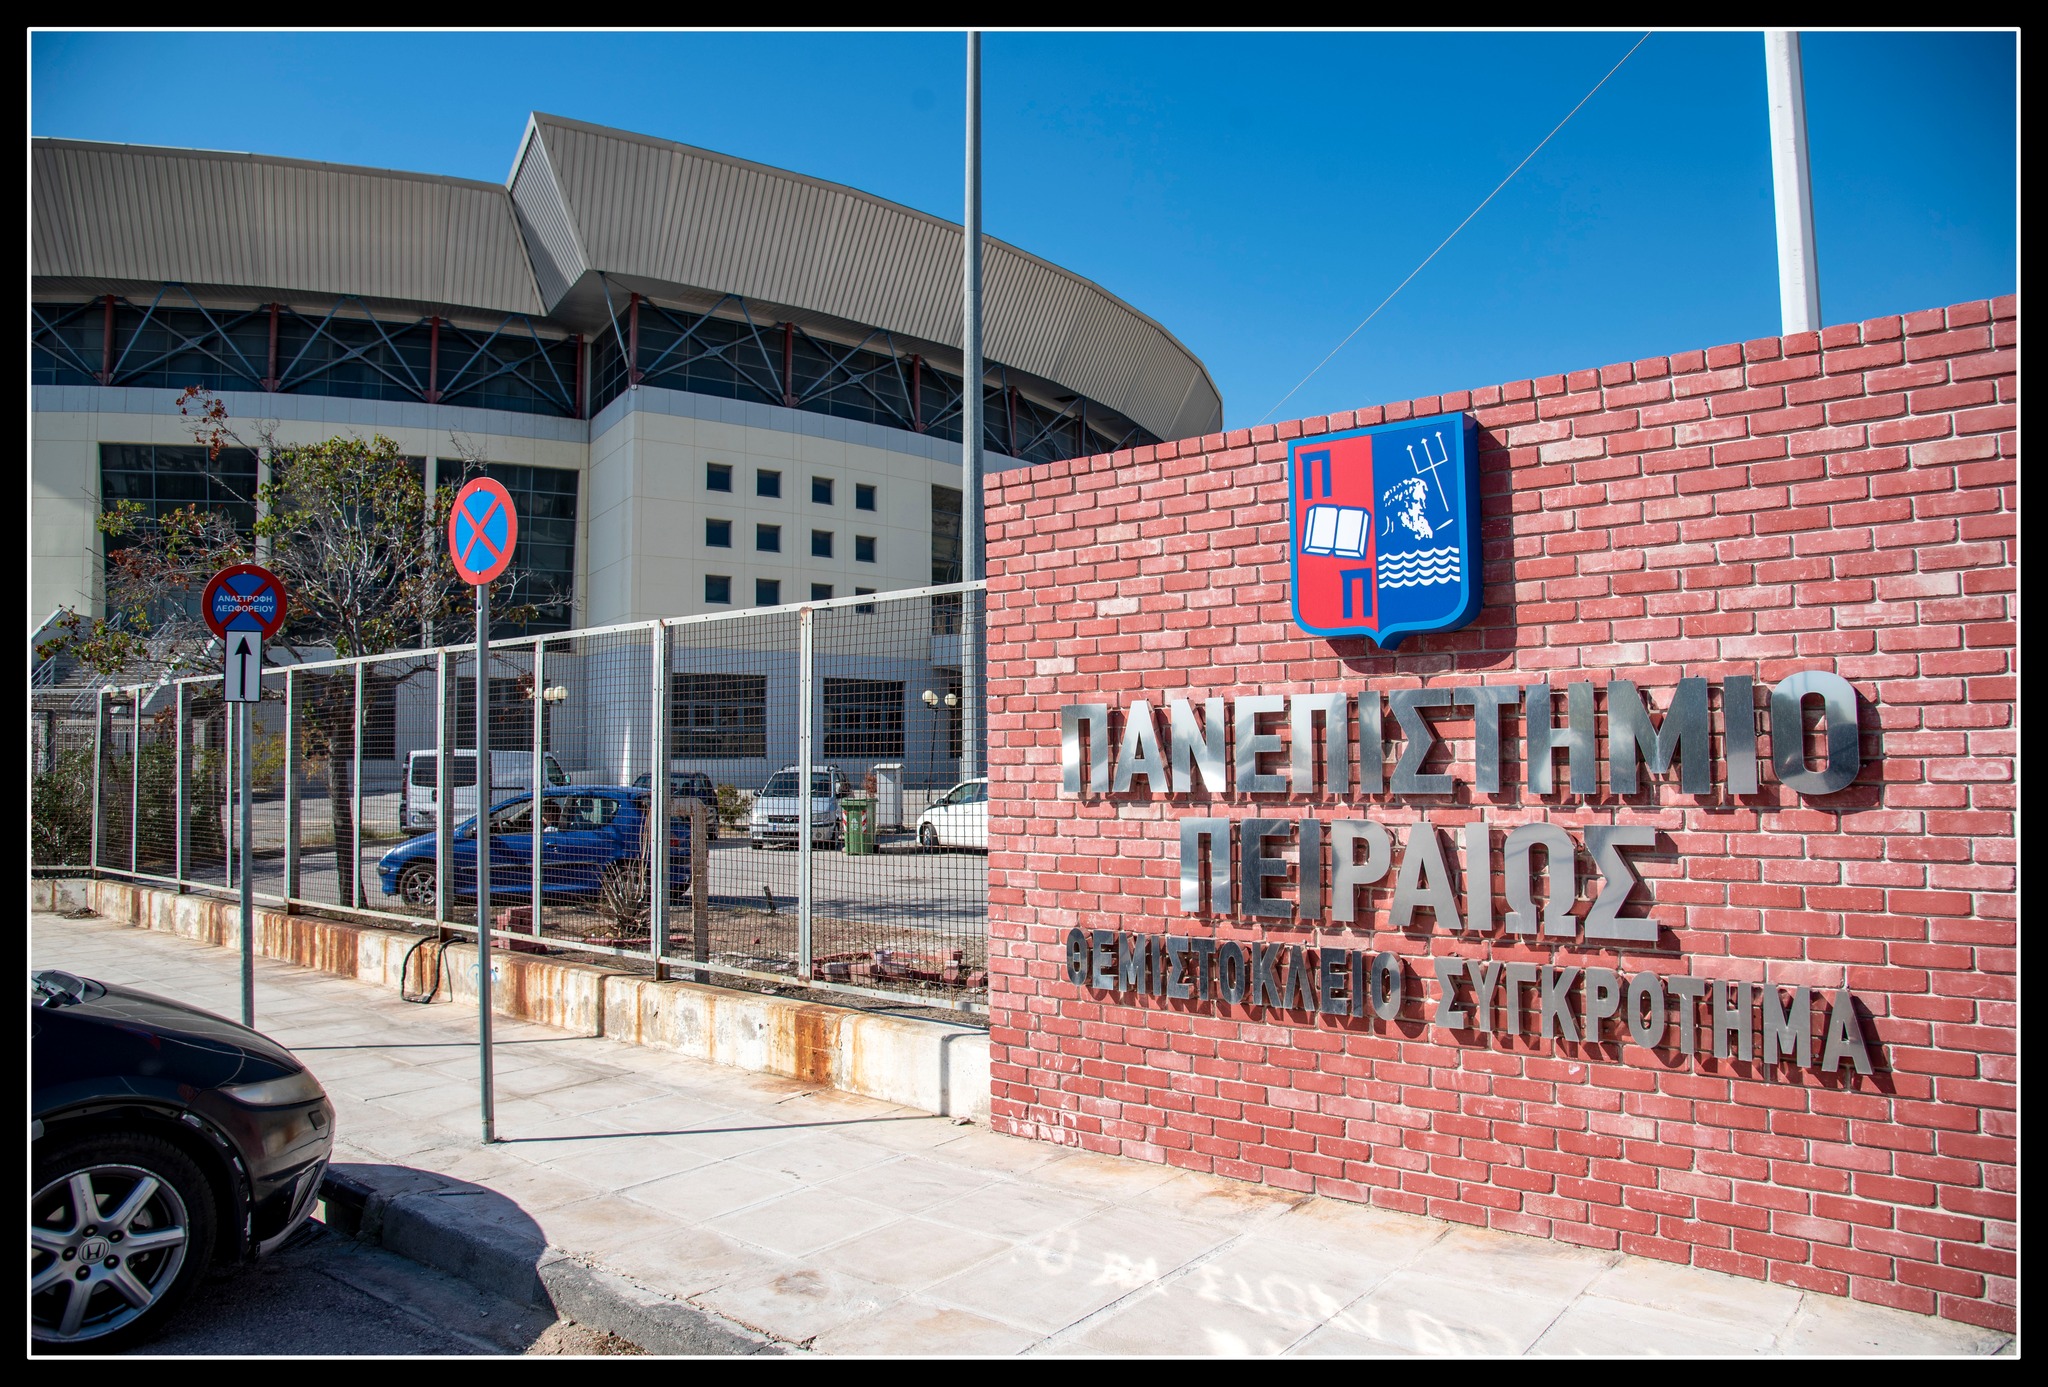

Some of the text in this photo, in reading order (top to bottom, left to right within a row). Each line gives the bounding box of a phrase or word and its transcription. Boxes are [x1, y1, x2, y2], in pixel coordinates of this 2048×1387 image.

[215, 605, 274, 613] ΛΕΩΦΟΡΕΙΟΥ
[217, 595, 273, 603] ΑΝΑΣΤΡΟΦΗ
[1060, 670, 1860, 796] ΠΑΝΕΠΙΣΤΗΜΙΟ
[1179, 817, 1660, 943] ΠΕΙΡΑΙΩΣ
[1066, 927, 1874, 1077] ΘΕΜΙΣΤΟΚΛΕΙΟ ΣΥΓΚΡΟΤΗΜΑ
